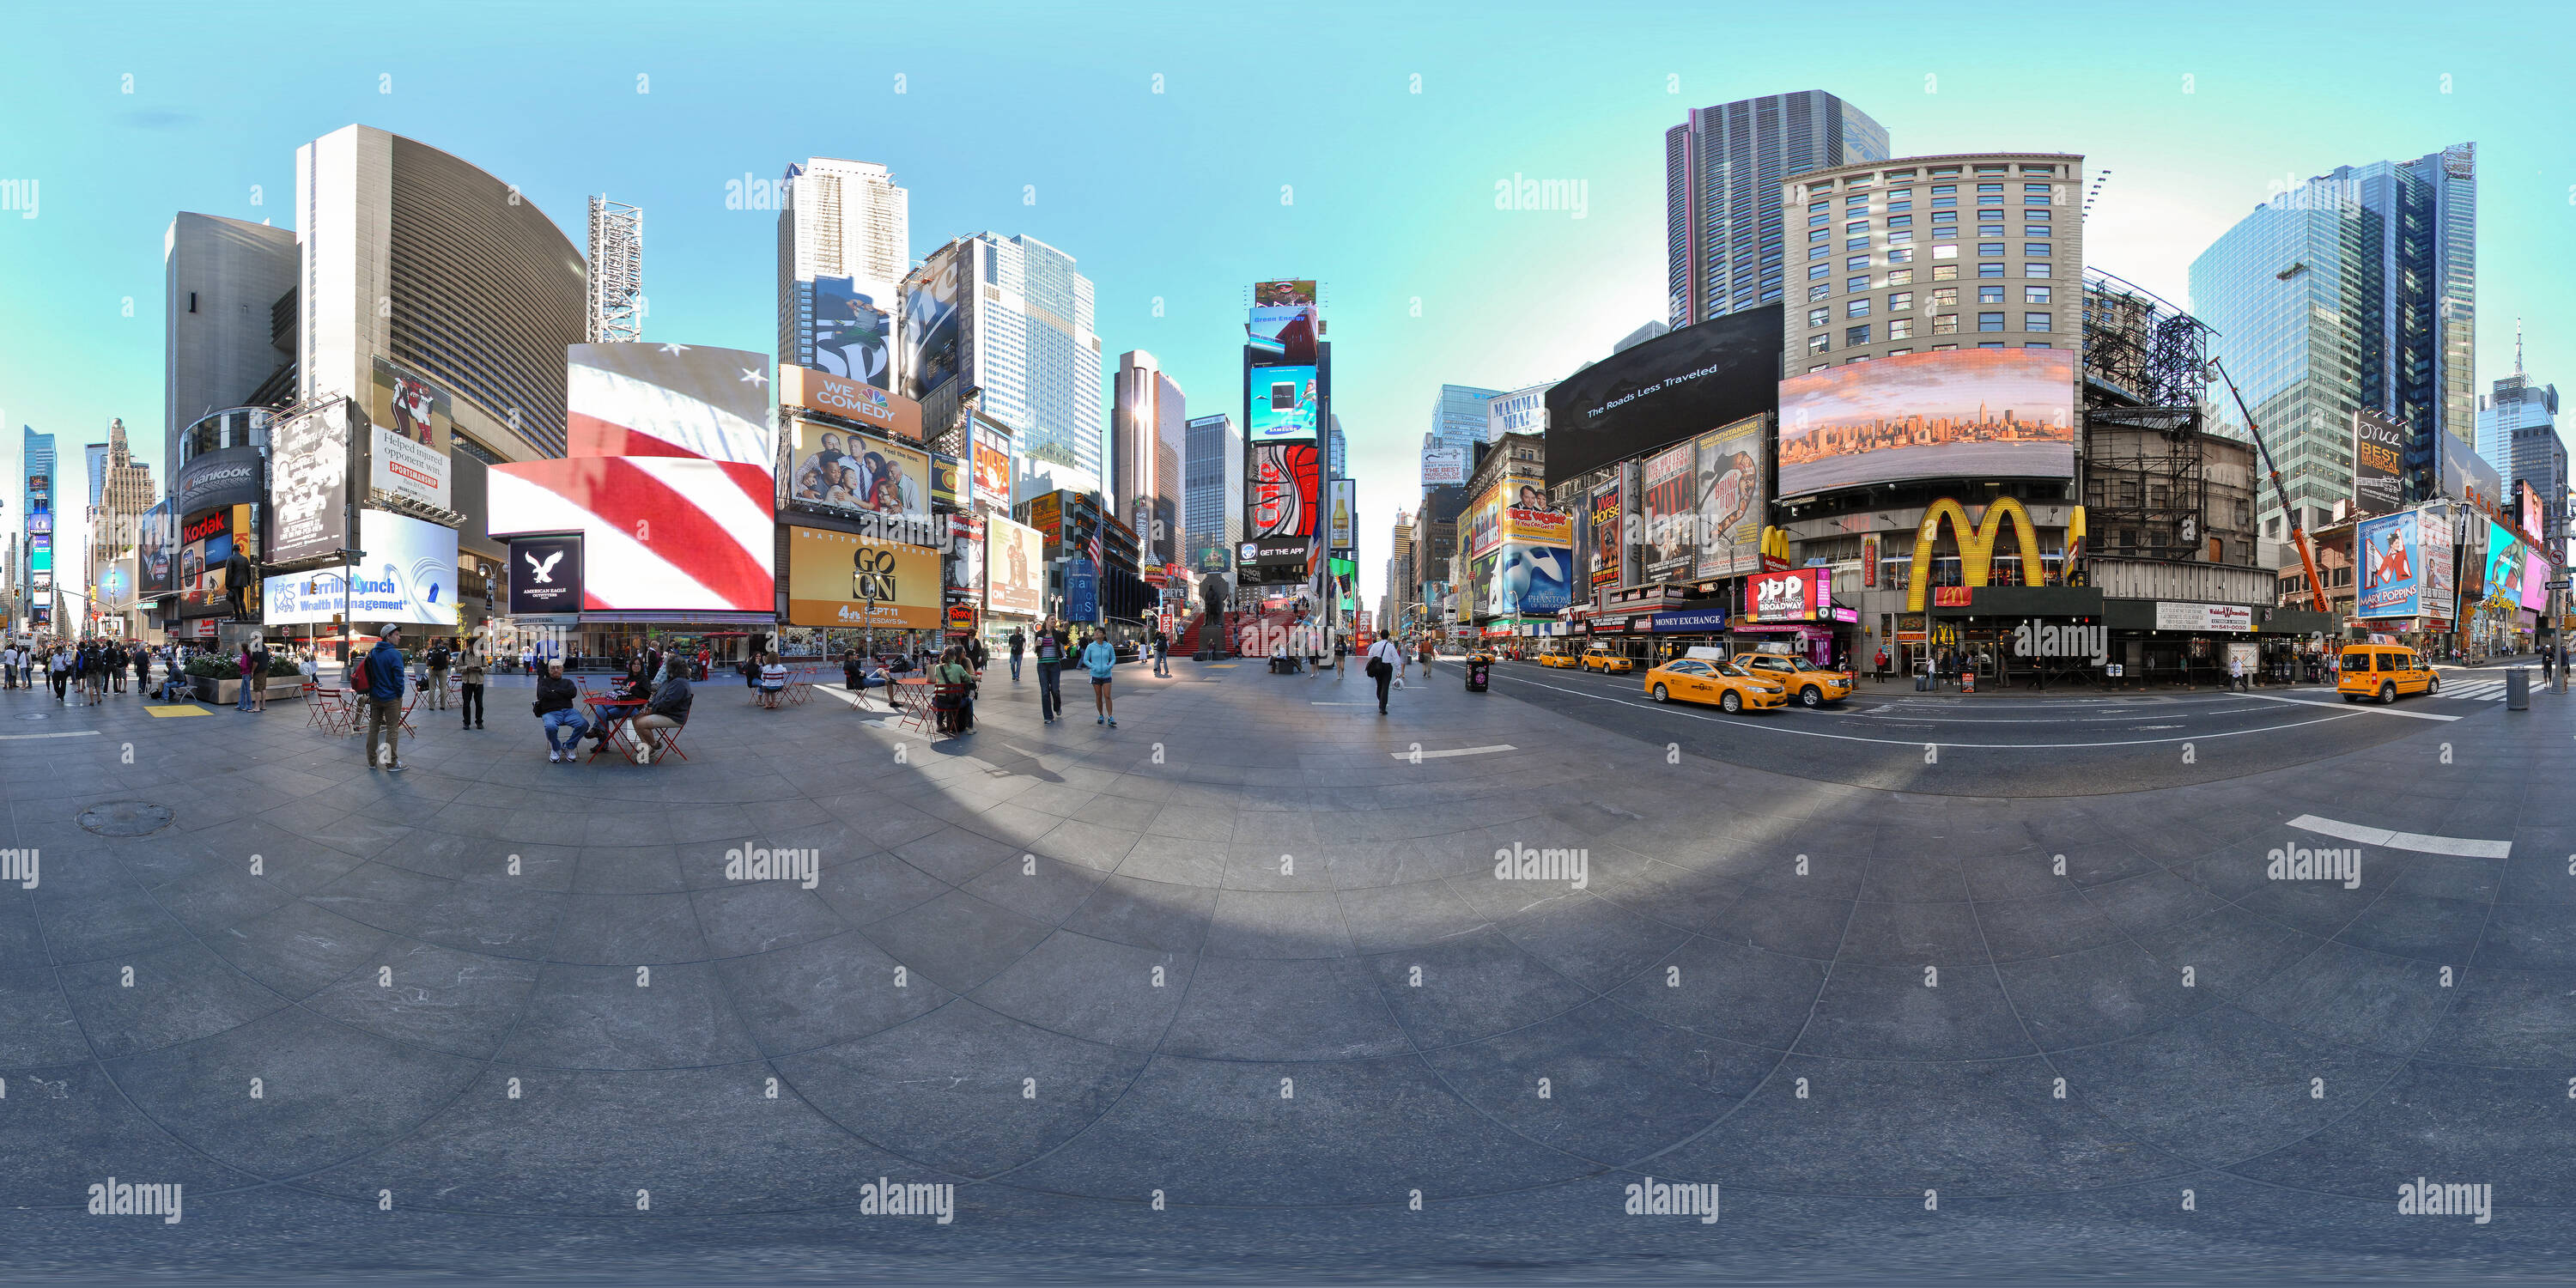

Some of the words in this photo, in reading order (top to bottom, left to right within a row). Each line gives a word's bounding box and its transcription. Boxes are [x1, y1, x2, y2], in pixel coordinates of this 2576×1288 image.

[1278, 314, 1306, 323] Energy
[823, 379, 855, 398] WE
[1587, 408, 1605, 419] The
[1607, 392, 1635, 410] Roads
[1637, 382, 1662, 398] Less
[1663, 363, 1718, 388] Traveled
[817, 391, 896, 422] COMEDY
[1493, 393, 1540, 418] MAMMA
[1268, 424, 1298, 433] SAMSUNG
[1503, 410, 1530, 431] MIA!
[1700, 421, 1759, 447] BREATHTAKING
[384, 433, 416, 453] Helped
[416, 446, 442, 466] injured
[1700, 439, 1720, 451] HUMAN
[2360, 440, 2400, 464] BEST
[384, 447, 425, 469] opponent
[425, 464, 442, 477] win.
[884, 447, 896, 456] Feel
[907, 454, 920, 463] love.
[1647, 462, 1659, 475] THE
[1660, 446, 1689, 468] HOTTEST
[2360, 453, 2398, 471] MUSICAL
[391, 462, 438, 488] SPORTSMANSHIP
[1255, 462, 1280, 529] Coke
[1646, 471, 1692, 517] EVITA
[1715, 472, 1738, 500] BRING
[1596, 492, 1619, 513] War
[1725, 489, 1736, 509] ON
[1505, 507, 1532, 521] NICE
[1532, 510, 1566, 526] WORK
[1592, 502, 1619, 526] Horse
[183, 512, 225, 544] Kodak
[947, 520, 983, 534] CHICAGO
[893, 544, 934, 557] PERRY
[1290, 547, 1304, 556] APP
[1720, 555, 1759, 565] ENGGEMENT
[854, 547, 896, 574] GO
[350, 576, 395, 595] Lynch
[854, 573, 896, 601] ON
[1592, 573, 1607, 583] BEST
[1701, 582, 1714, 592] FUEL
[992, 589, 1005, 600] CNN
[1528, 594, 1571, 604] PHANTOM
[1646, 587, 1662, 598] Annie
[1667, 586, 1684, 598] Annie
[2360, 592, 2382, 607] MARY
[2381, 583, 2417, 602] POPPINS
[2421, 586, 2452, 600] NEWSIES
[838, 605, 849, 619] 4
[864, 605, 890, 617] SEPT
[890, 607, 898, 617] 11
[1759, 600, 1802, 611] BROADWAY
[1162, 615, 1171, 634] tkts
[1359, 612, 1372, 632] tkts
[1634, 617, 1652, 629] Annie
[1655, 617, 1679, 626] MONEY
[1680, 615, 1721, 625] EXCHANGE
